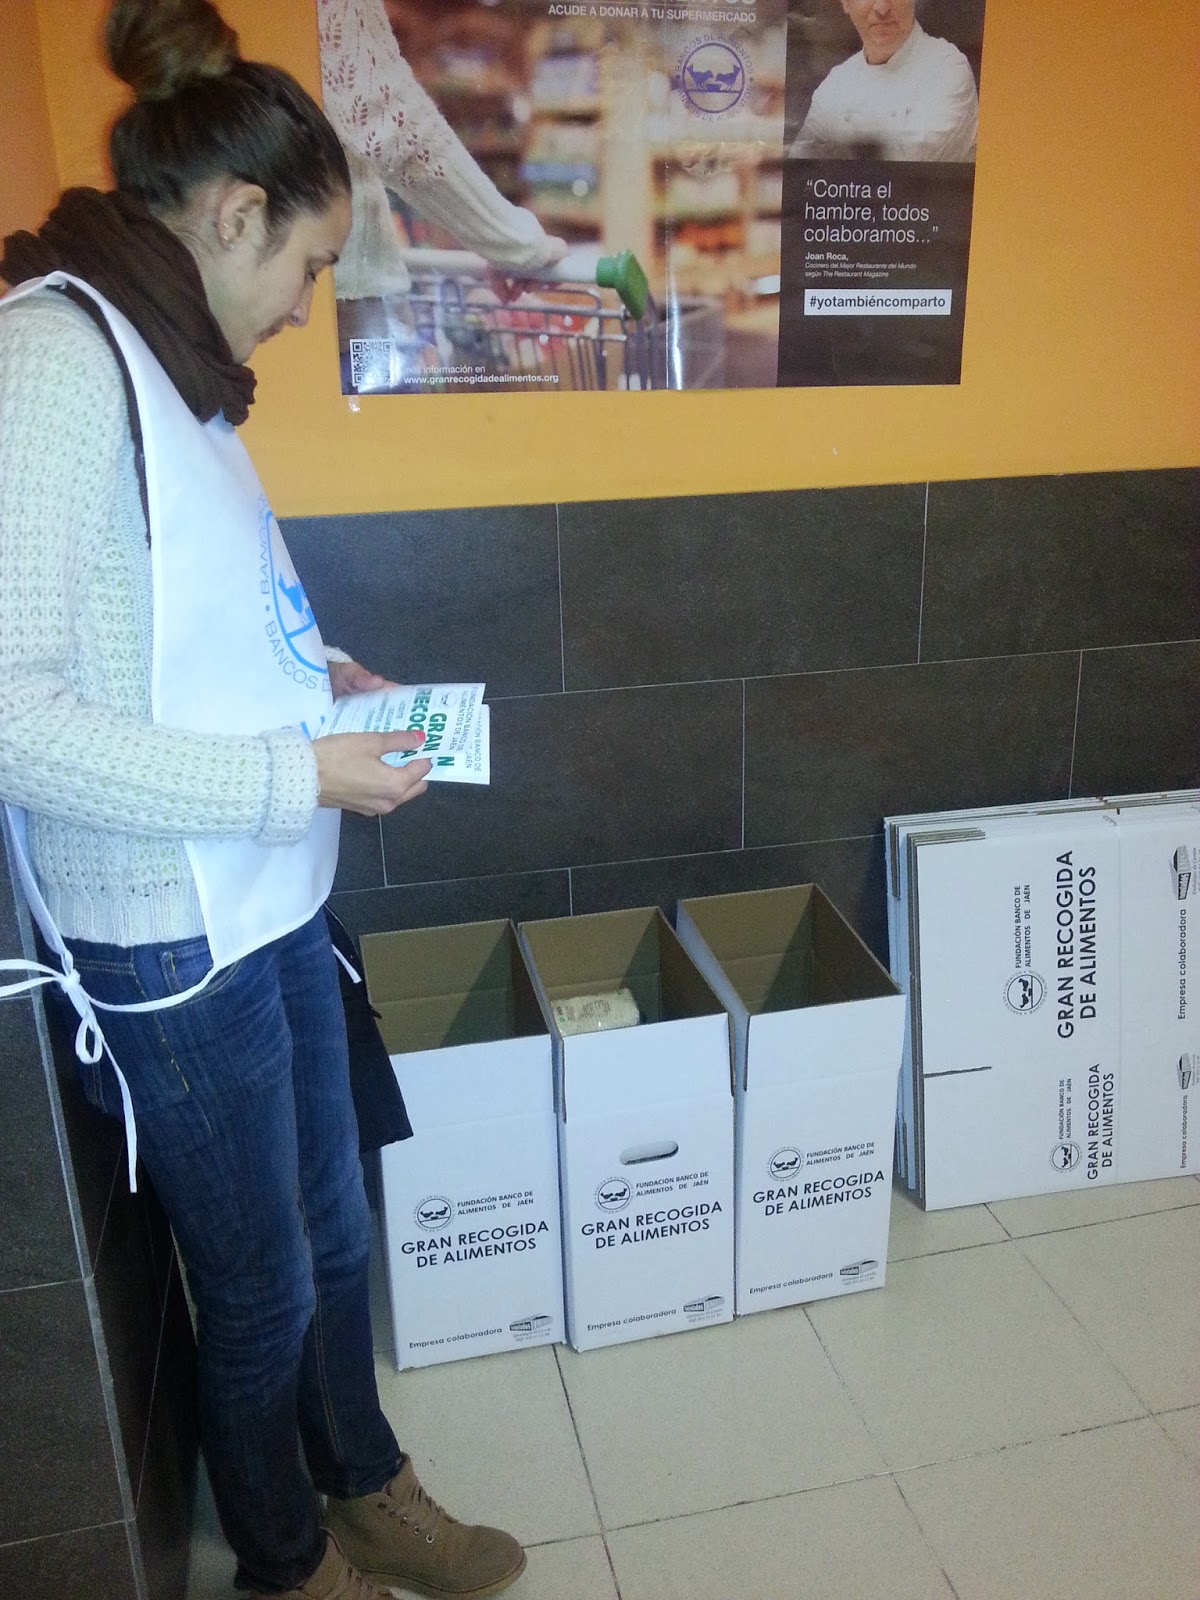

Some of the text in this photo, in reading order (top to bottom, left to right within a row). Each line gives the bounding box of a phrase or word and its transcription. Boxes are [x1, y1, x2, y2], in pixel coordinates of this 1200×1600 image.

[548, 4, 756, 22] ACUDE A DONAR A TU SUPERMERCADO
[877, 182, 892, 198] el
[804, 202, 930, 223] hambre, todos
[805, 252, 849, 261] Joan Roca,
[840, 262, 855, 270] Mejor
[863, 271, 890, 279] Magazine
[809, 295, 946, 310] #yotambiéncomparto
[404, 373, 559, 384] www.granrecogidadealimentos.org
[423, 365, 473, 374] información
[474, 366, 486, 374] en
[265, 621, 317, 690] BANCOS
[422, 712, 448, 752] GRAN
[1014, 886, 1021, 896] DE
[1024, 909, 1031, 920] DE
[1013, 923, 1022, 968] FUNDACIÓN
[1056, 850, 1074, 1038] GRAN RECOGIDA
[1079, 866, 1096, 1018] DE ALIMENTOS
[1178, 908, 1187, 976] colaboradora
[1178, 978, 1187, 1020] Empresa
[1059, 1078, 1064, 1086] DE
[1066, 1096, 1072, 1104] DE
[1087, 1063, 1100, 1180] GRAN RECOGIDA
[1102, 1073, 1114, 1168] DE ALIMENTOS
[844, 1144, 865, 1152] BANCO
[806, 1155, 841, 1166] ALIMENTOS
[676, 1174, 698, 1182] BANCO
[753, 1170, 885, 1204] GRAN RECOGIDA
[498, 1192, 522, 1201] BANCO
[636, 1186, 674, 1196] ALIMENTOS
[765, 1186, 872, 1216] DE ALIMENTOS
[458, 1204, 496, 1216] ALIMENTOS
[581, 1201, 722, 1236] GRAN RECOGIDA
[401, 1220, 549, 1254] GRAN RECOGIDA
[596, 1218, 710, 1249] DE ALIMENTOS
[416, 1238, 536, 1268] DE ALIMENTOS
[750, 1283, 782, 1294] Empresa
[783, 1273, 833, 1288] colaboradora
[587, 1320, 621, 1331] Empresa
[623, 1309, 677, 1324] colaboradora
[409, 1337, 444, 1349] Empresa
[446, 1328, 502, 1343] colaboradora
